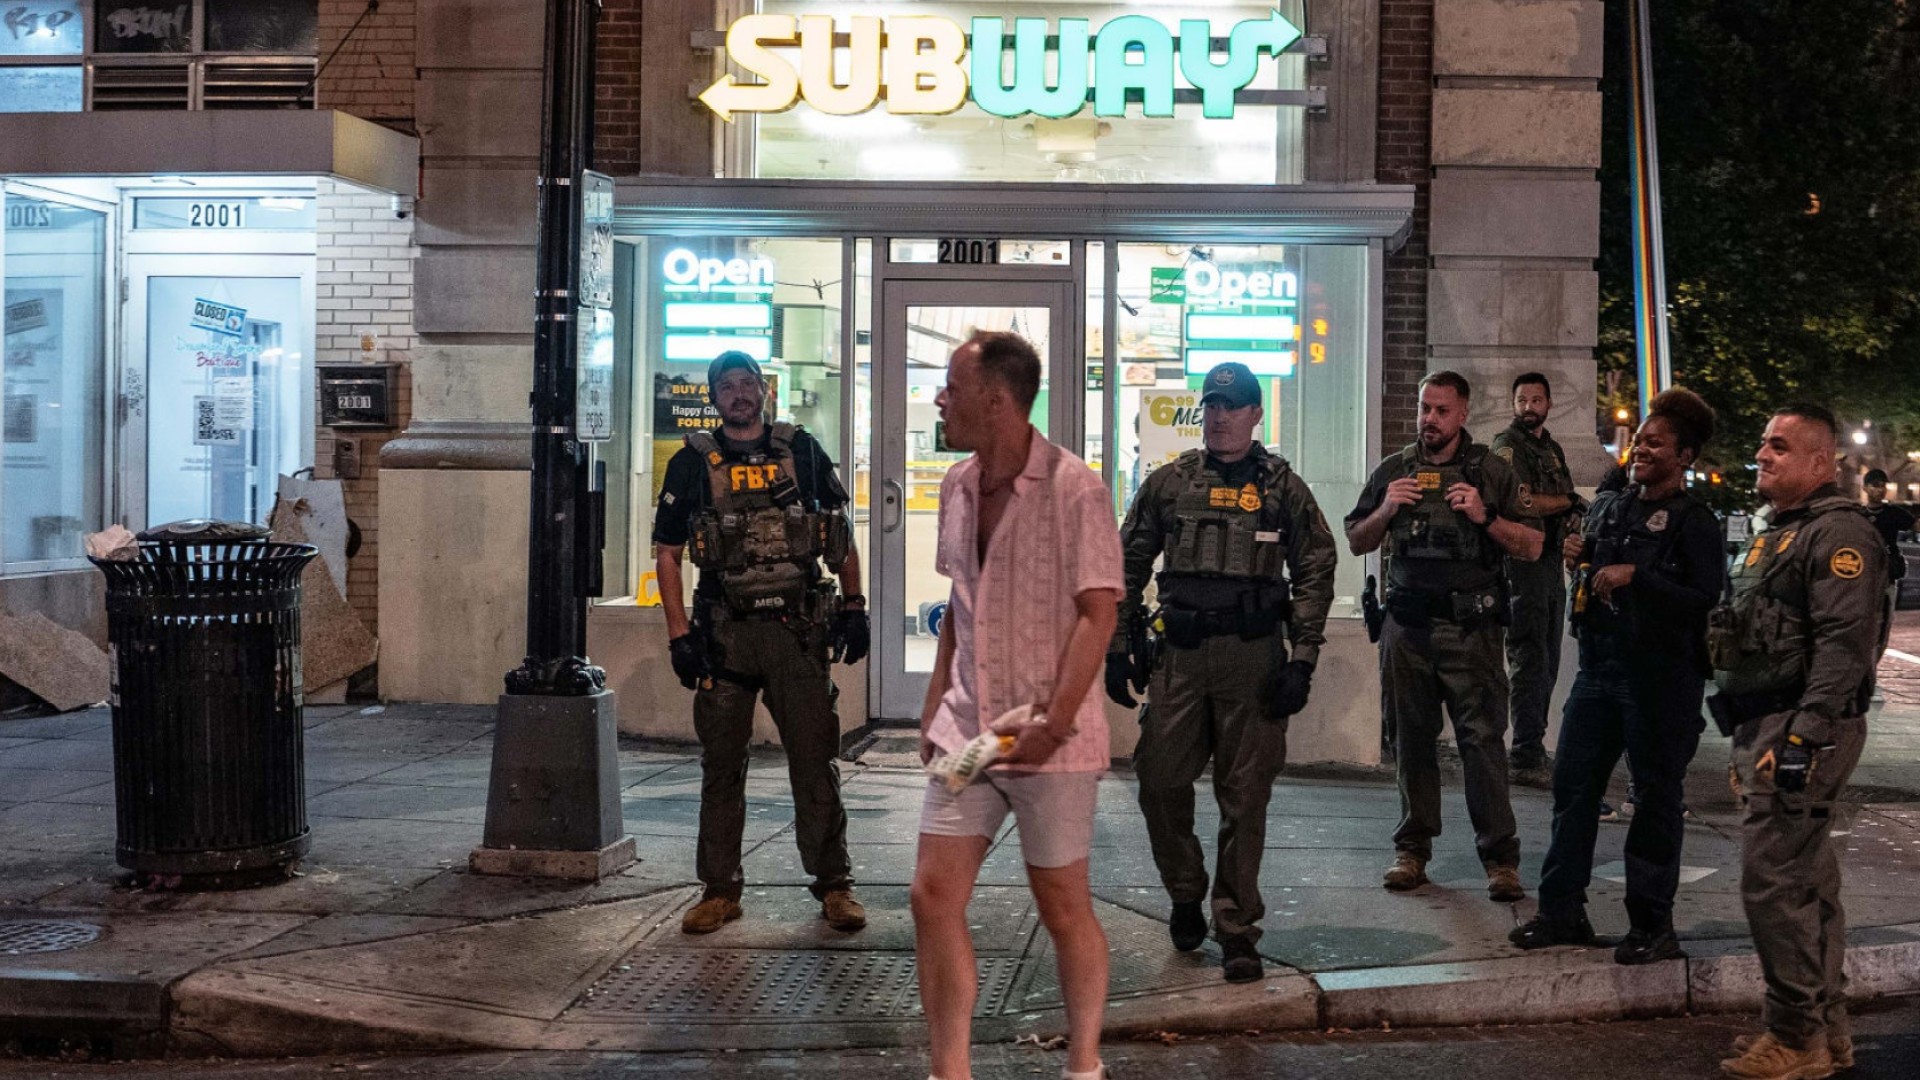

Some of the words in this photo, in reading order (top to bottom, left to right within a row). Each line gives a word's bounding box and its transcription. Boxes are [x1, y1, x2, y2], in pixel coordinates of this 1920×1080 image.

[699, 8, 1302, 125] SUBWAY
[190, 204, 244, 227] 2001
[938, 240, 998, 264] 2001
[663, 248, 774, 293] Open
[1185, 260, 1297, 308] Open
[194, 301, 227, 321] CLOSED
[672, 384, 697, 394] BUY
[339, 397, 370, 408] 2001
[672, 405, 702, 417] Happy
[677, 417, 702, 428] FOR
[1176, 427, 1202, 437] THE
[731, 463, 779, 491] FBI
